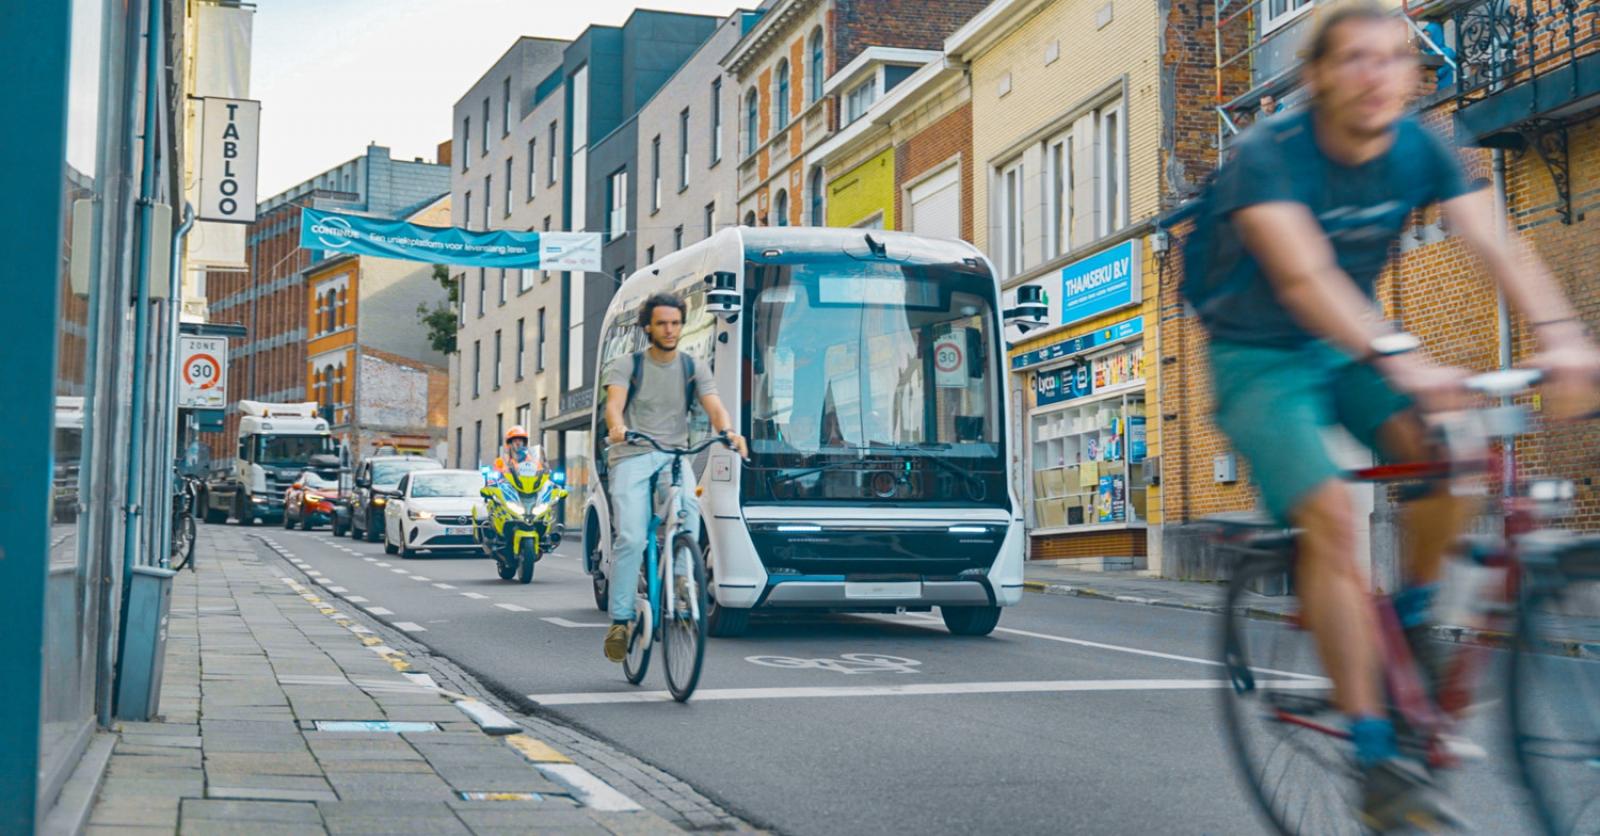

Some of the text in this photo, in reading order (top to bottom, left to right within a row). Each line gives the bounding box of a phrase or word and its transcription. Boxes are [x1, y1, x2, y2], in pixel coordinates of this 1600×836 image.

[219, 103, 239, 215] TABLOO
[311, 224, 360, 239] CONTINUE
[369, 232, 385, 242] Een
[445, 242, 463, 250] voor
[1066, 263, 1112, 297] THAMSEKU
[189, 341, 216, 350] ZONE
[939, 351, 956, 362] 30
[192, 364, 212, 378] 30
